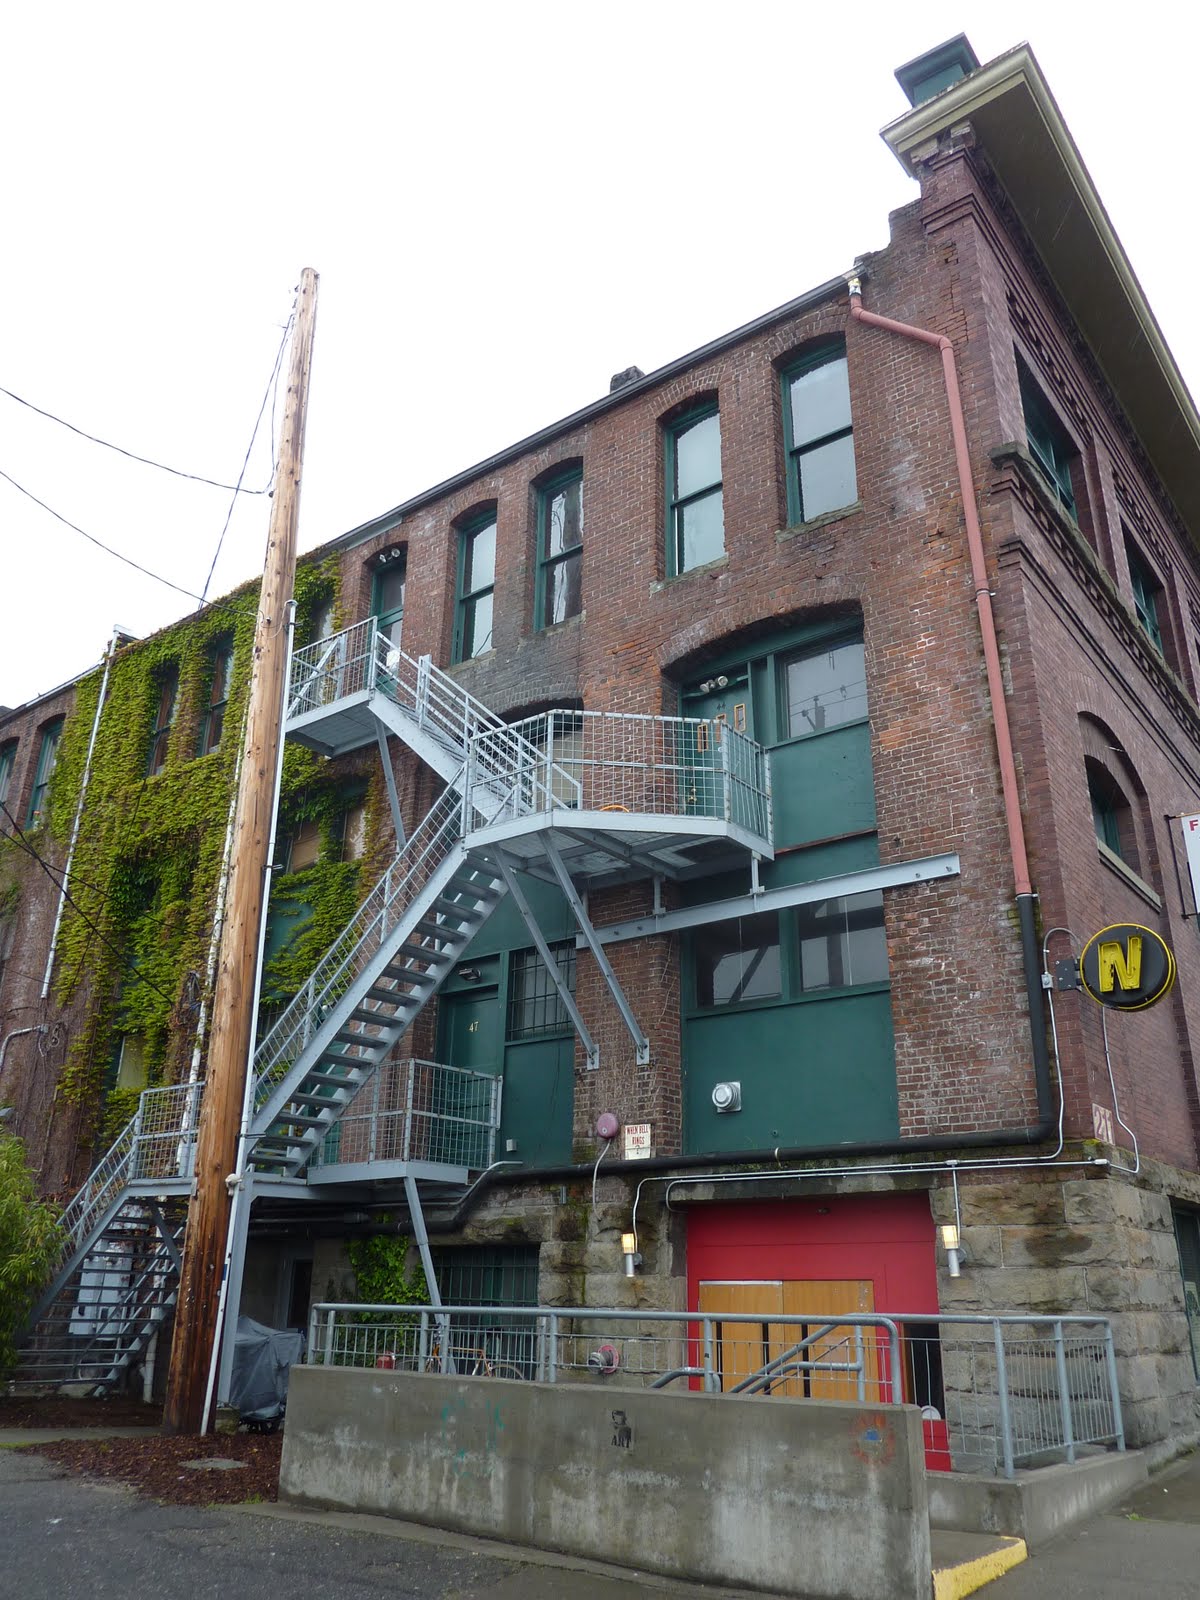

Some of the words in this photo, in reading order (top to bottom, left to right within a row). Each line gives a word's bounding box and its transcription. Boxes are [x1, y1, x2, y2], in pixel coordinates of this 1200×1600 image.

[1098, 934, 1142, 992] N
[469, 1021, 479, 1032] 47
[627, 1126, 638, 1134] WHEN
[639, 1125, 649, 1133] BELL
[632, 1136, 645, 1145] RINGS
[611, 1435, 630, 1448] ART
